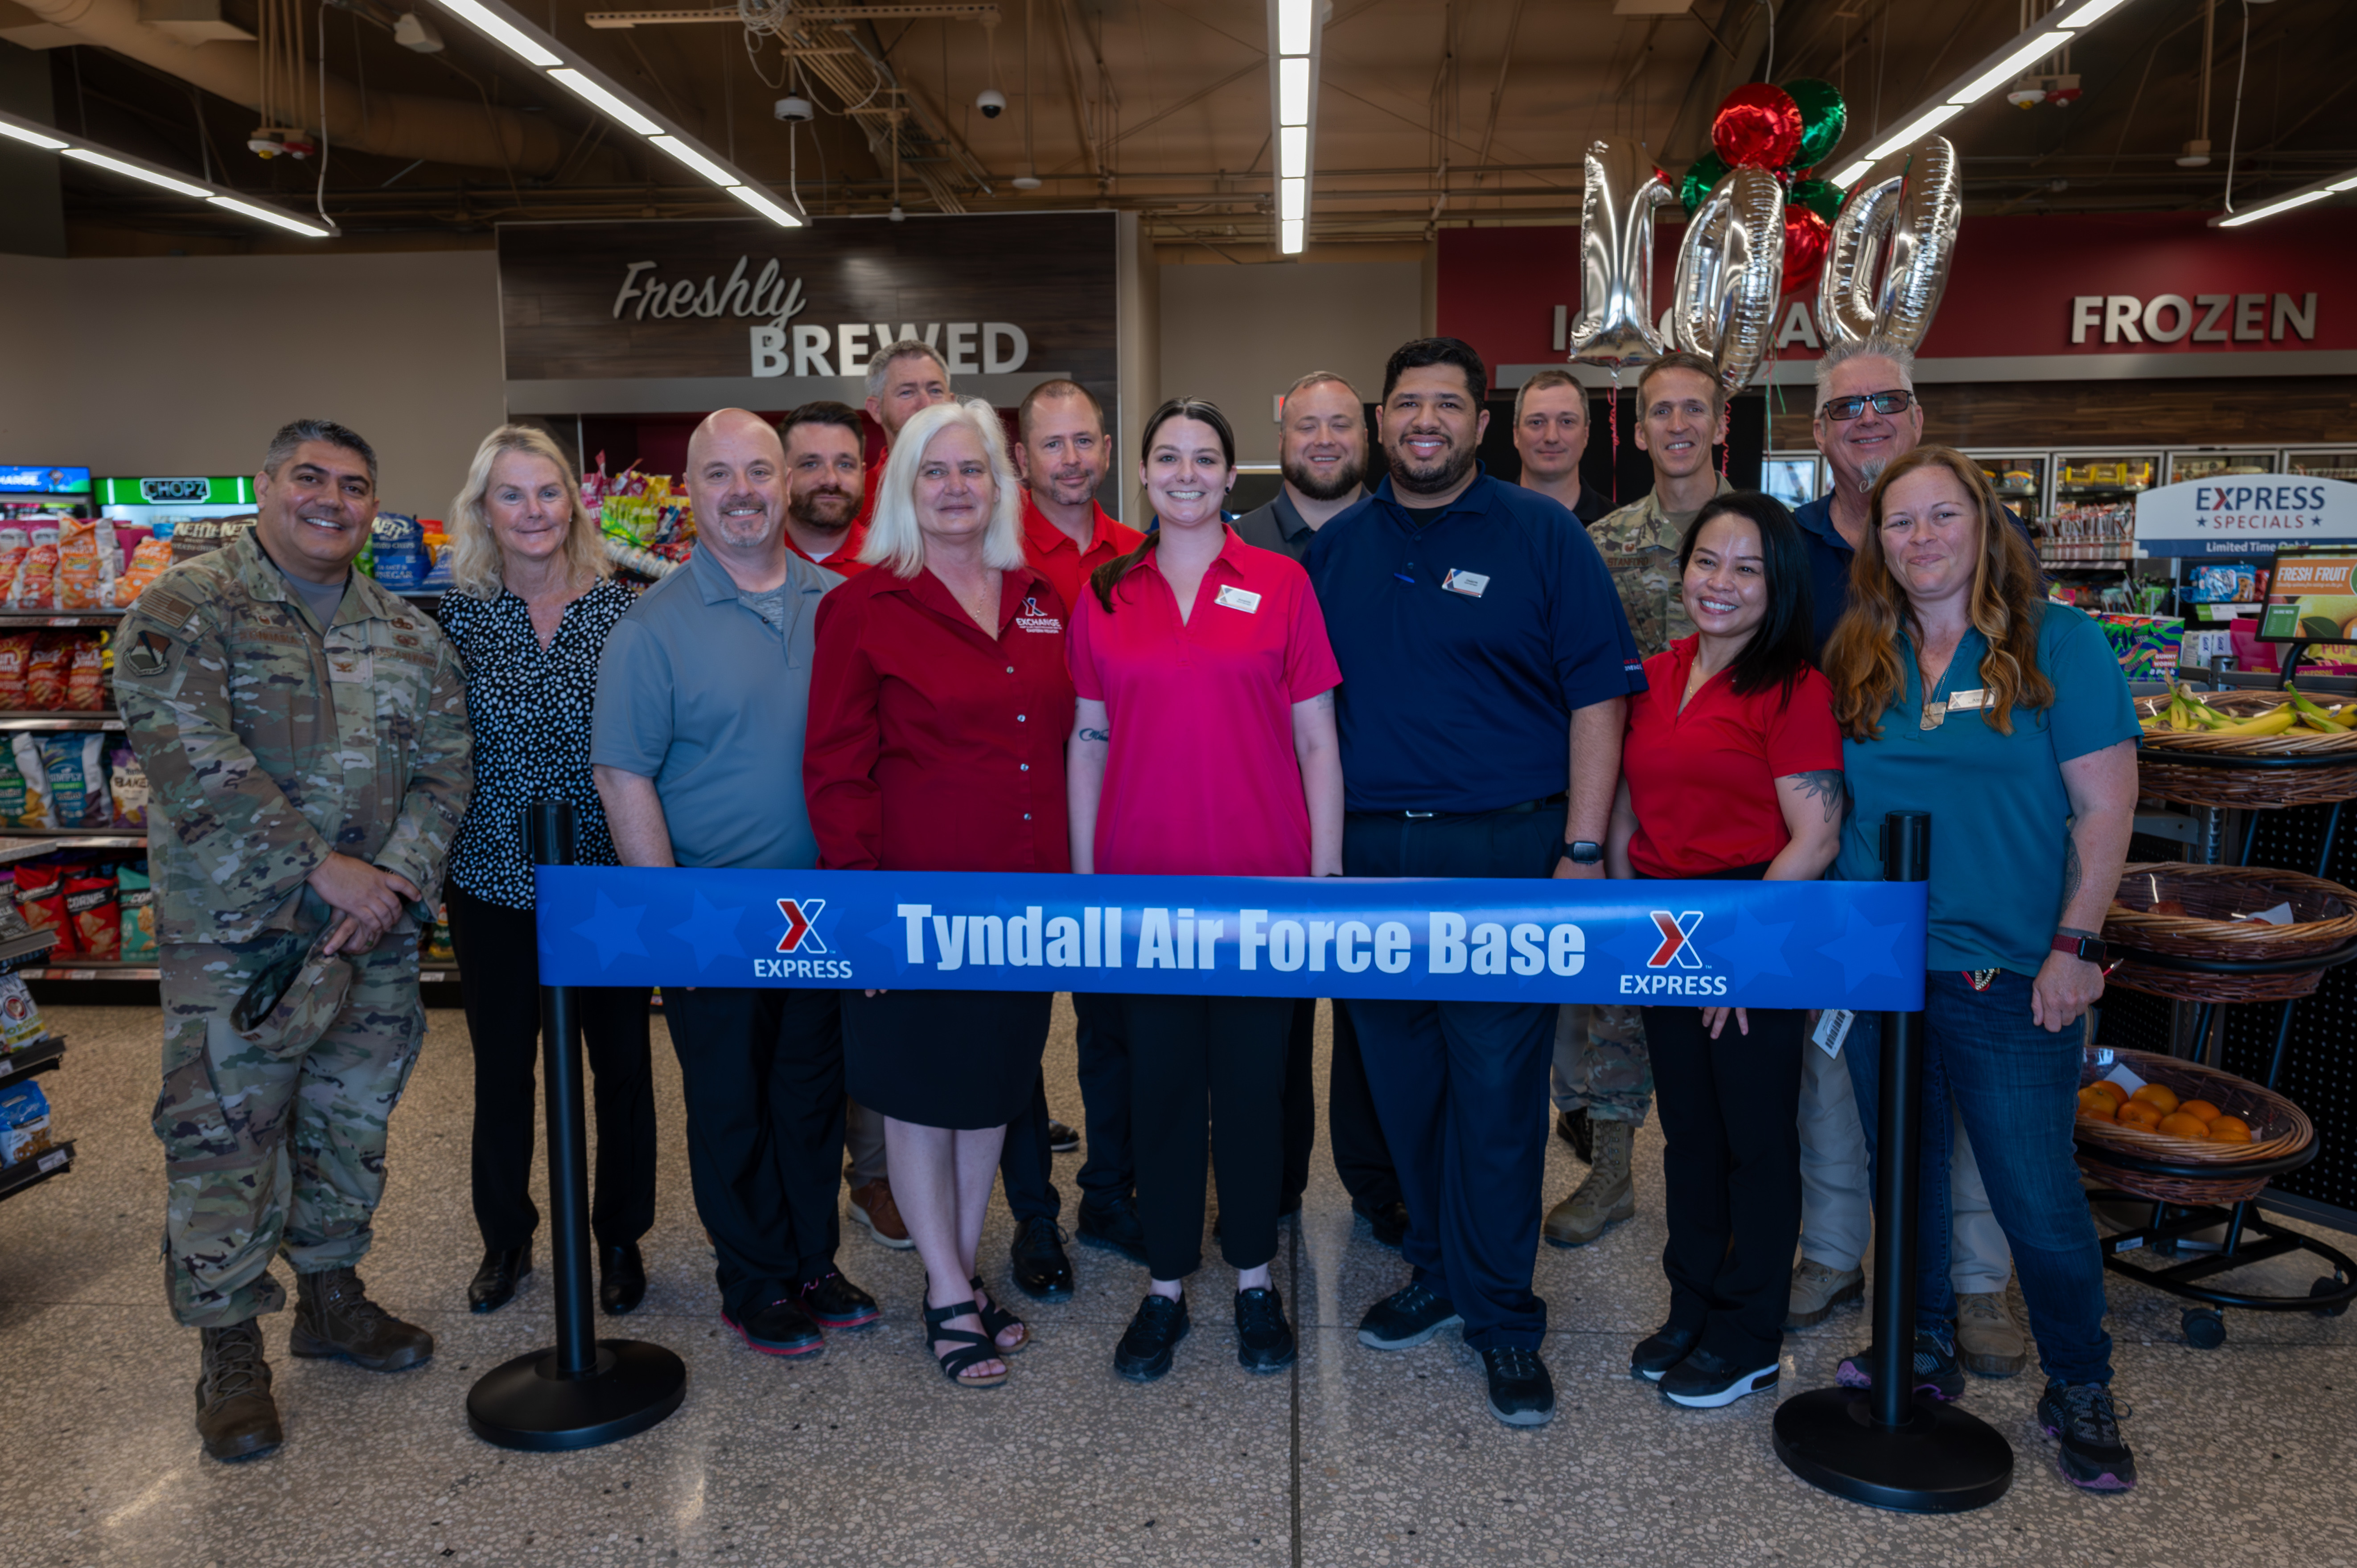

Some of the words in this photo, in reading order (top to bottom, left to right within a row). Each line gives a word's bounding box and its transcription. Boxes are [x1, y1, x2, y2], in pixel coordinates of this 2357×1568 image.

[613, 254, 807, 332] Freshly
[2071, 292, 2318, 343] FROZEN
[0, 475, 41, 486] HARGE.
[144, 480, 206, 497] CHOPZ
[2196, 485, 2325, 511] EXPRESS
[2213, 515, 2304, 530] SPECIALS
[2206, 541, 2248, 552] Limited
[2250, 542, 2277, 553] Time
[1607, 557, 1649, 566] STANFORD
[2277, 566, 2313, 581] FRESH
[2315, 566, 2349, 581] FRUIT
[1016, 618, 1061, 627] EXCHANGE
[897, 903, 1122, 971] Tyndall
[1136, 907, 1223, 969] Air
[1239, 909, 1411, 973] Force
[1428, 911, 1585, 977] Base
[753, 958, 852, 979] EXPRESS
[1619, 974, 1728, 996] EXPRESS
